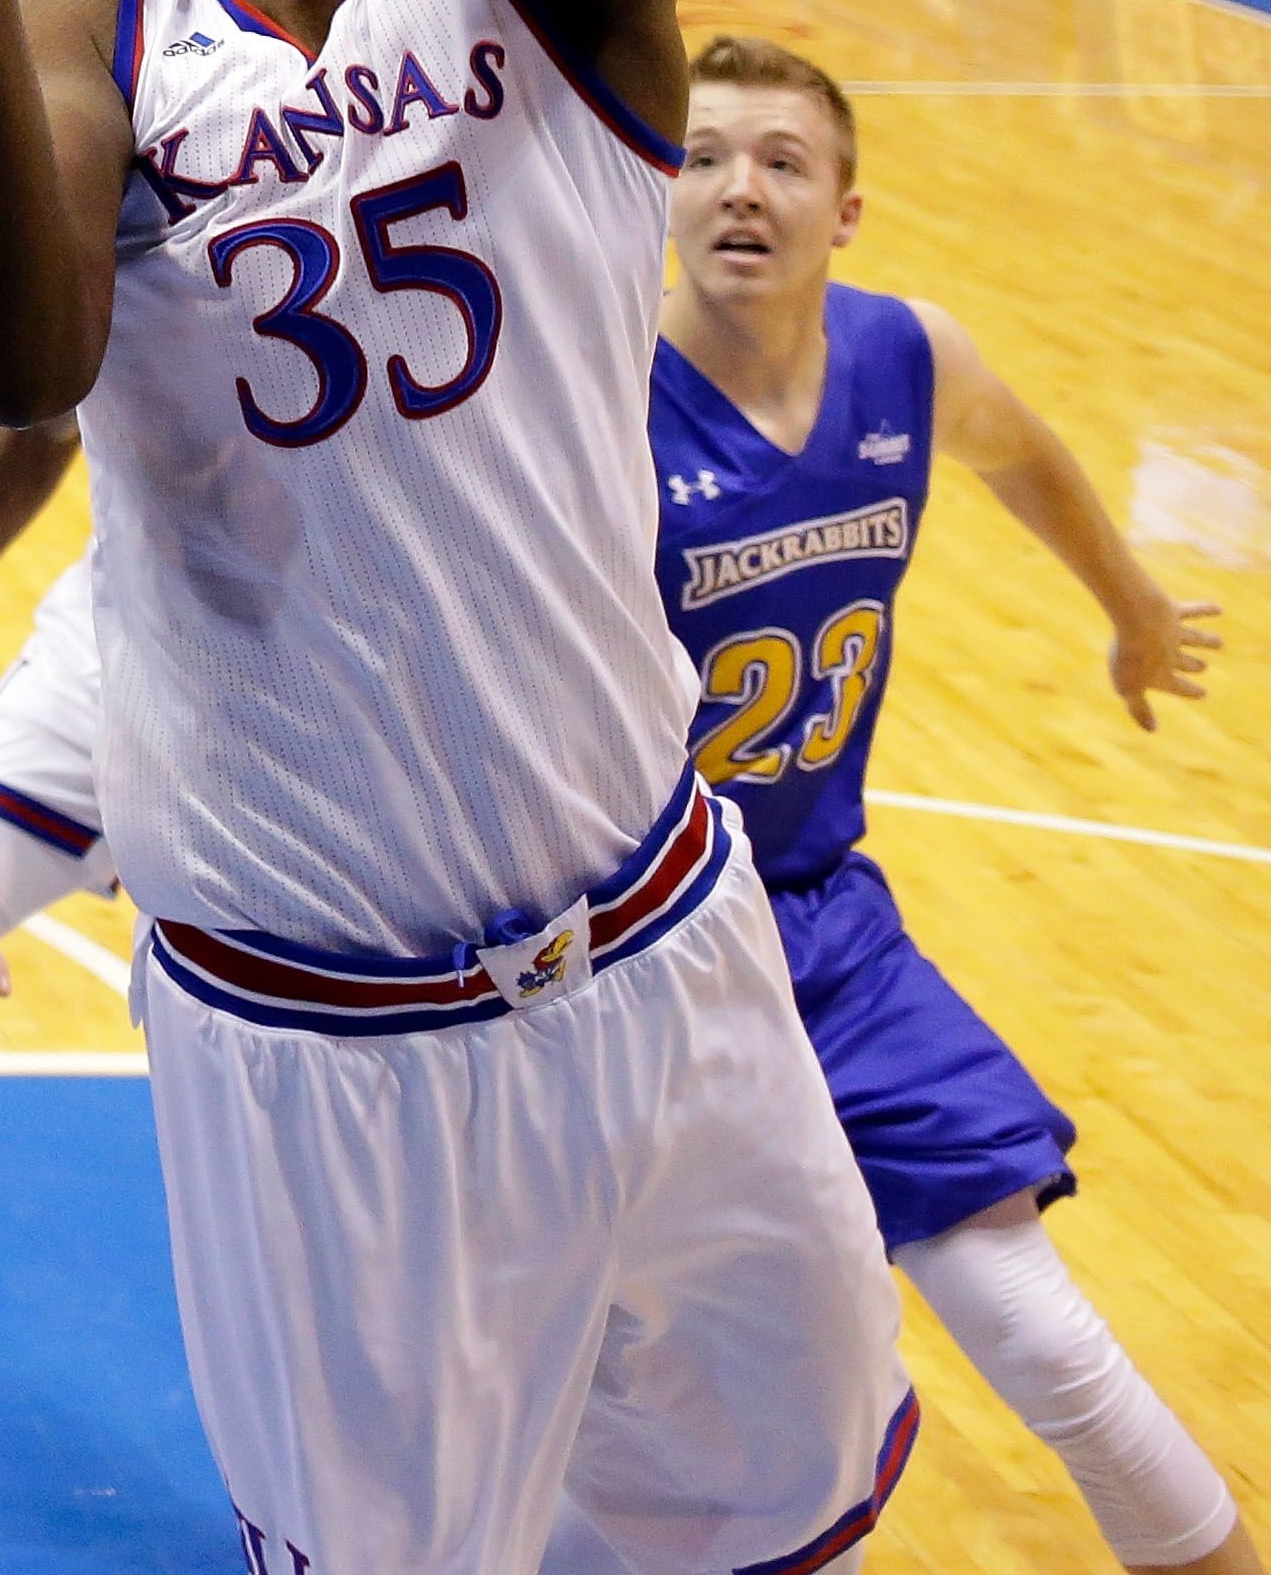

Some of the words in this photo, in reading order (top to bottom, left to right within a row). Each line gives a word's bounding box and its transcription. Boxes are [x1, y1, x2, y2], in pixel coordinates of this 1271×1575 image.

[138, 40, 506, 225] KANSAS
[207, 160, 504, 449] 35
[693, 505, 903, 599] JACKRABBITS
[693, 598, 885, 786] 23
